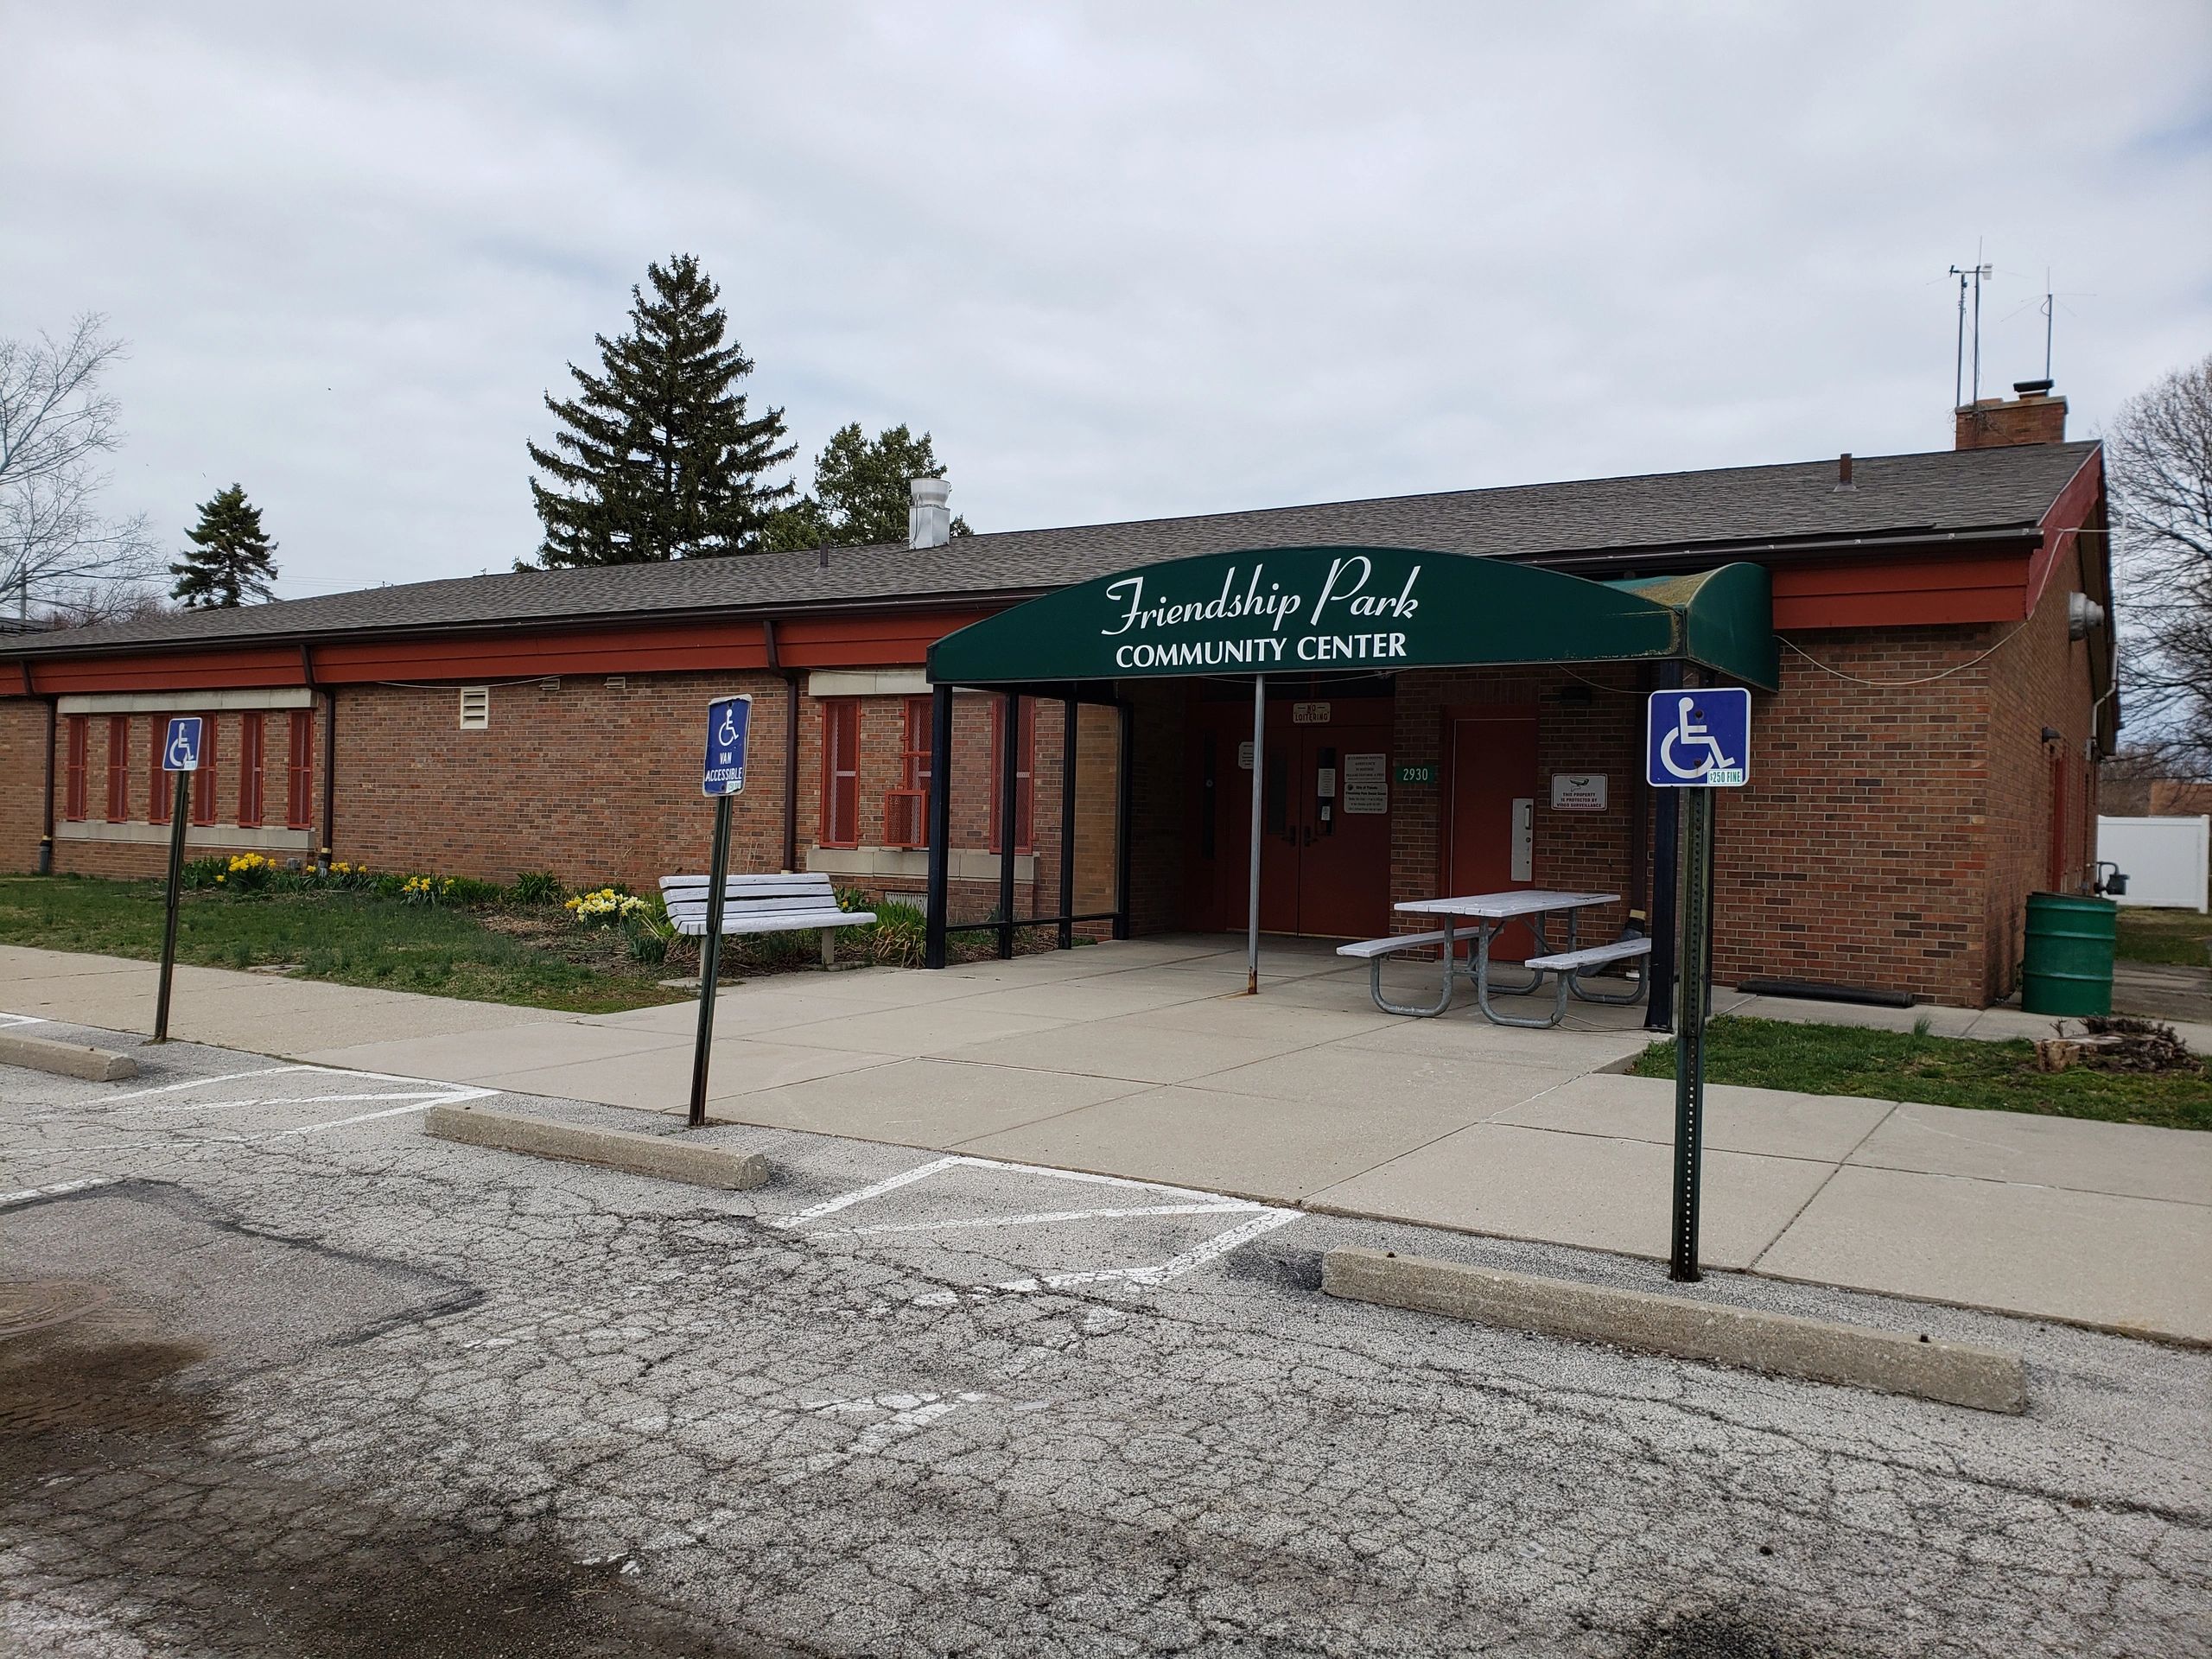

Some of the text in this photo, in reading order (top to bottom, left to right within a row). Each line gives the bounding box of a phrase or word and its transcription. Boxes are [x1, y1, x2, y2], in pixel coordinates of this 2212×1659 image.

[1101, 556, 1421, 636] Friendship Park
[1116, 632, 1408, 669] COMMUNITY CENTER
[1295, 713, 1328, 721] LOITERING
[720, 752, 732, 765] VAN
[705, 766, 743, 782] ACCESSIBLE
[1402, 768, 1428, 781] 2930
[1709, 771, 1740, 783] $250 FINE
